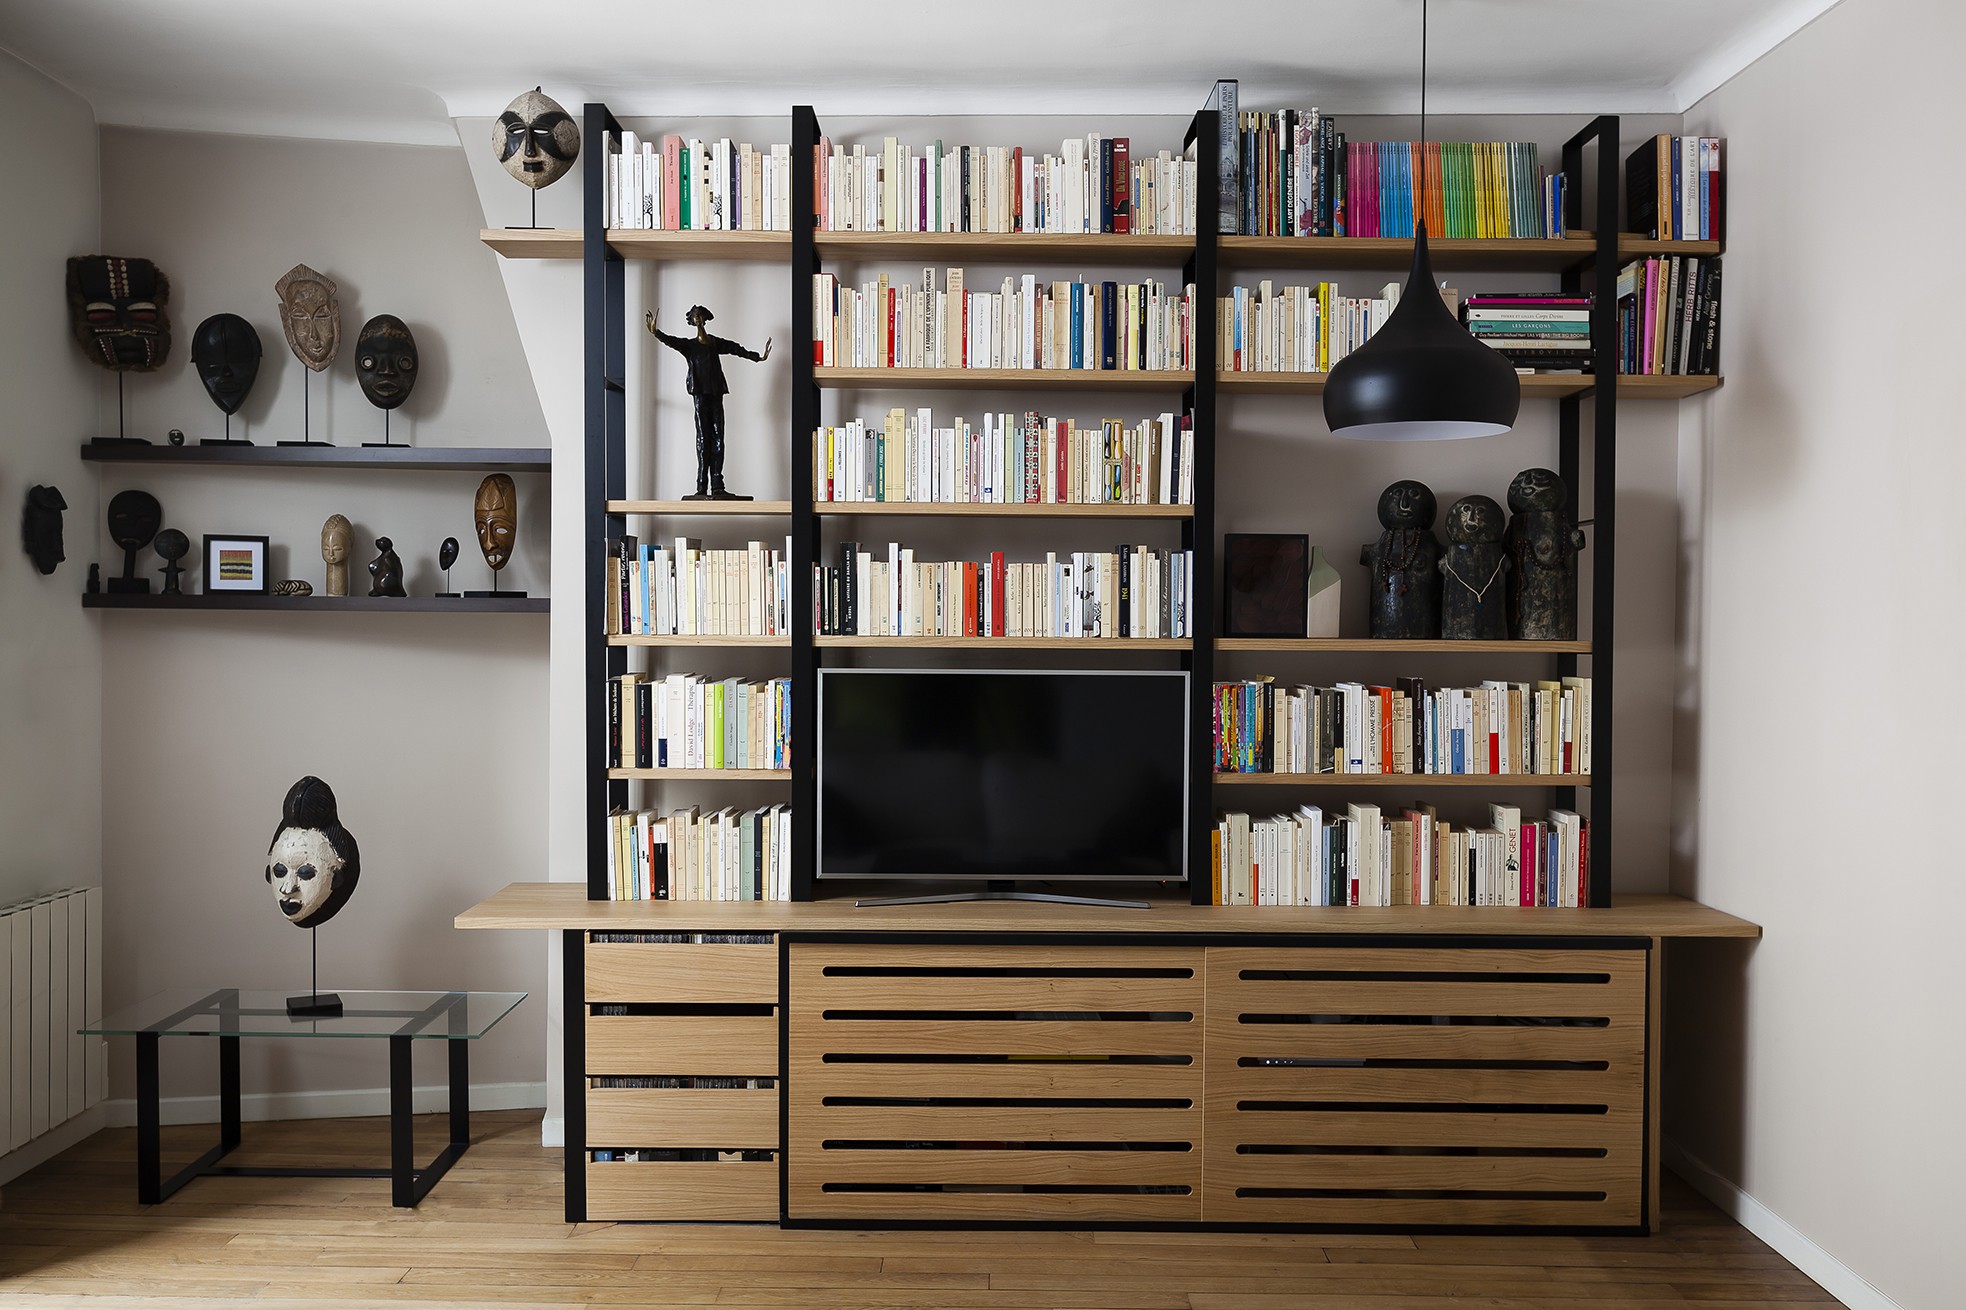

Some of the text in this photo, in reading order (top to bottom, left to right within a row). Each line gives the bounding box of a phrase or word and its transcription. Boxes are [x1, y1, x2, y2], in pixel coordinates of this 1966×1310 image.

[1222, 104, 1228, 112] DE
[1228, 120, 1233, 129] LA
[1690, 158, 1695, 167] DE
